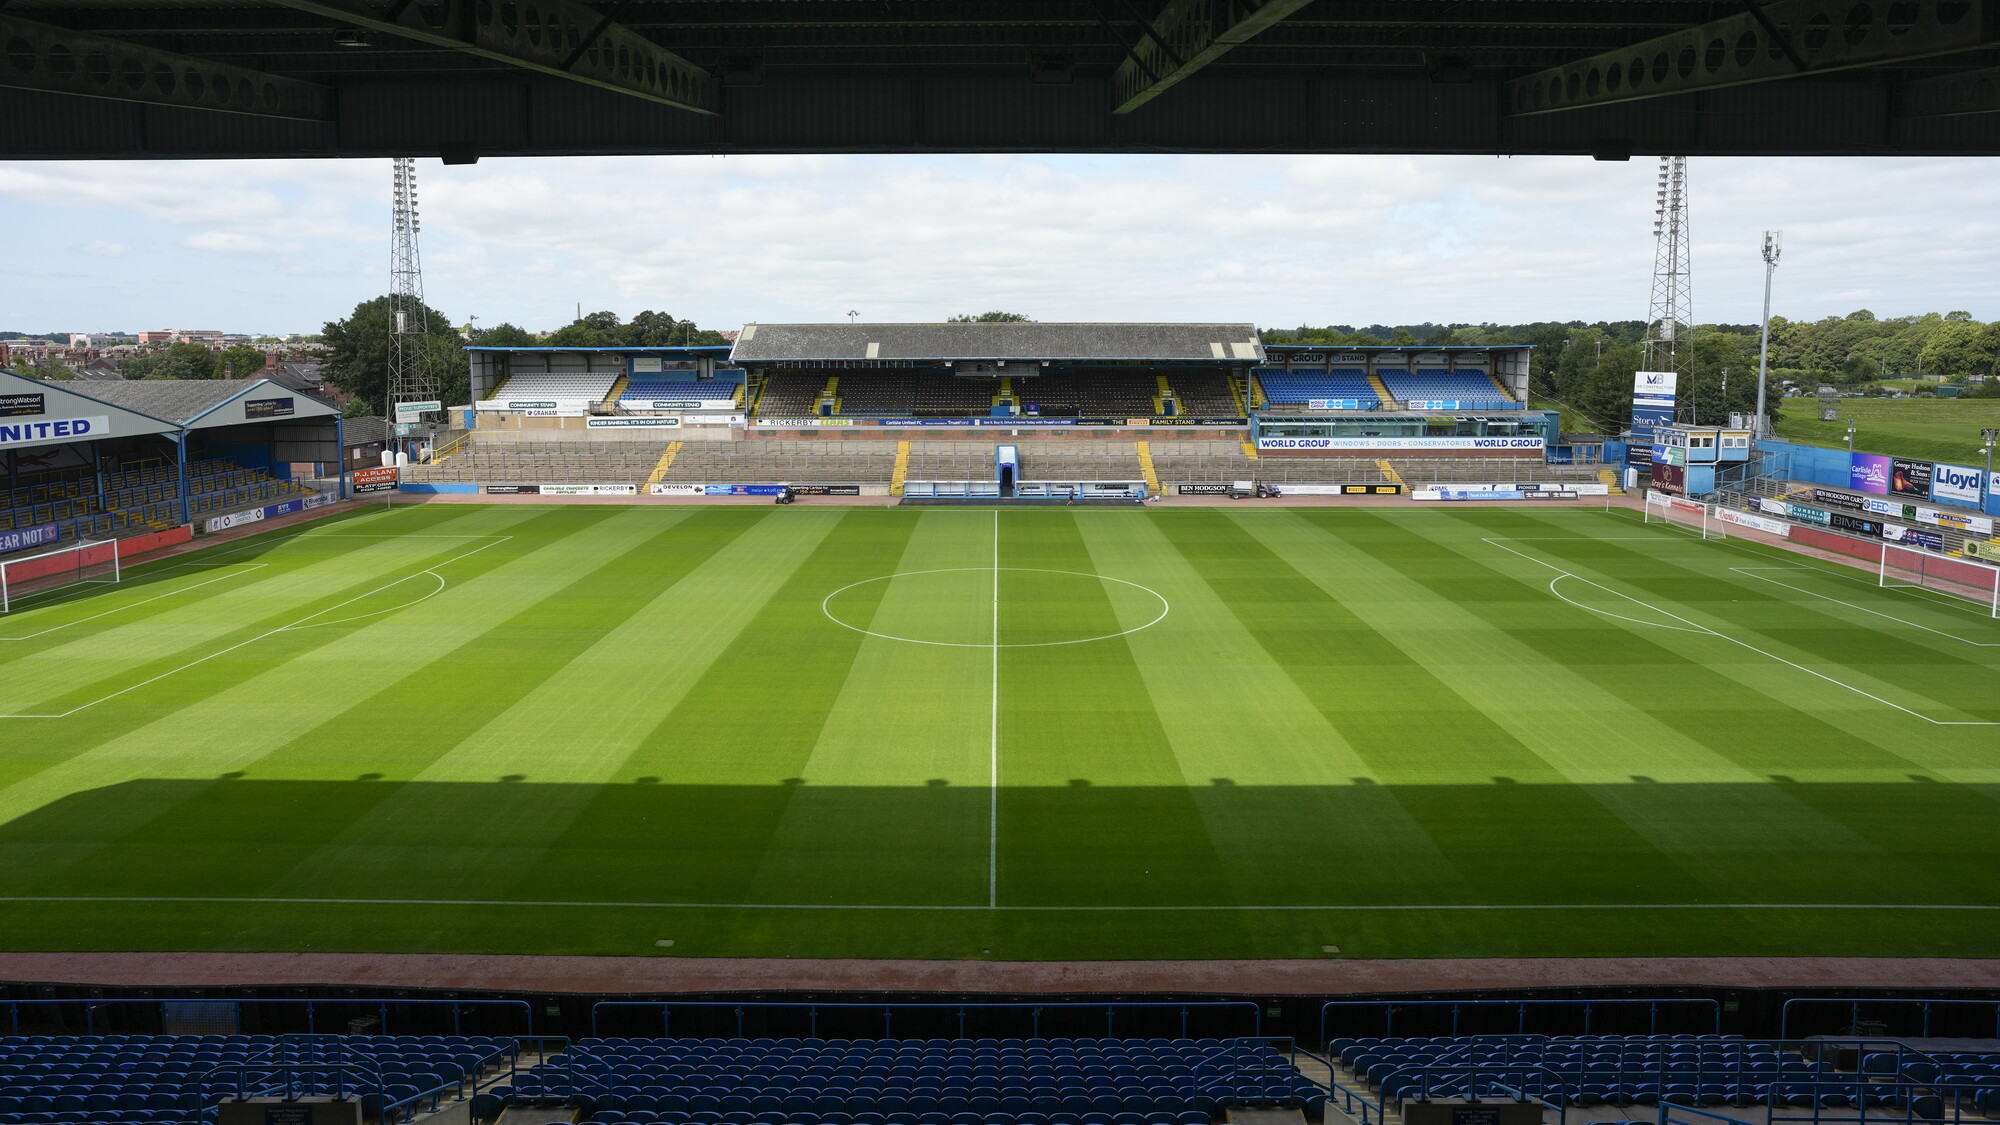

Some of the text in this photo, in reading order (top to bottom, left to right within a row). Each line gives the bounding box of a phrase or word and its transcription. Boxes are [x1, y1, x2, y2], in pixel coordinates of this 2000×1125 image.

[1292, 354, 1322, 362] GROUP
[1633, 414, 1656, 425] Story
[1852, 466, 1872, 474] Carlisle
[1894, 460, 1930, 471] George Hudson
[1936, 468, 1979, 490] Lloyd
[1652, 479, 1682, 492] Gray's Kennels
[1826, 492, 1849, 501] HODGSON
[1850, 496, 1863, 504] CARS
[1794, 505, 1824, 516] CUMBRIA
[1871, 500, 1888, 512] EEC
[22, 529, 42, 545] NOT
